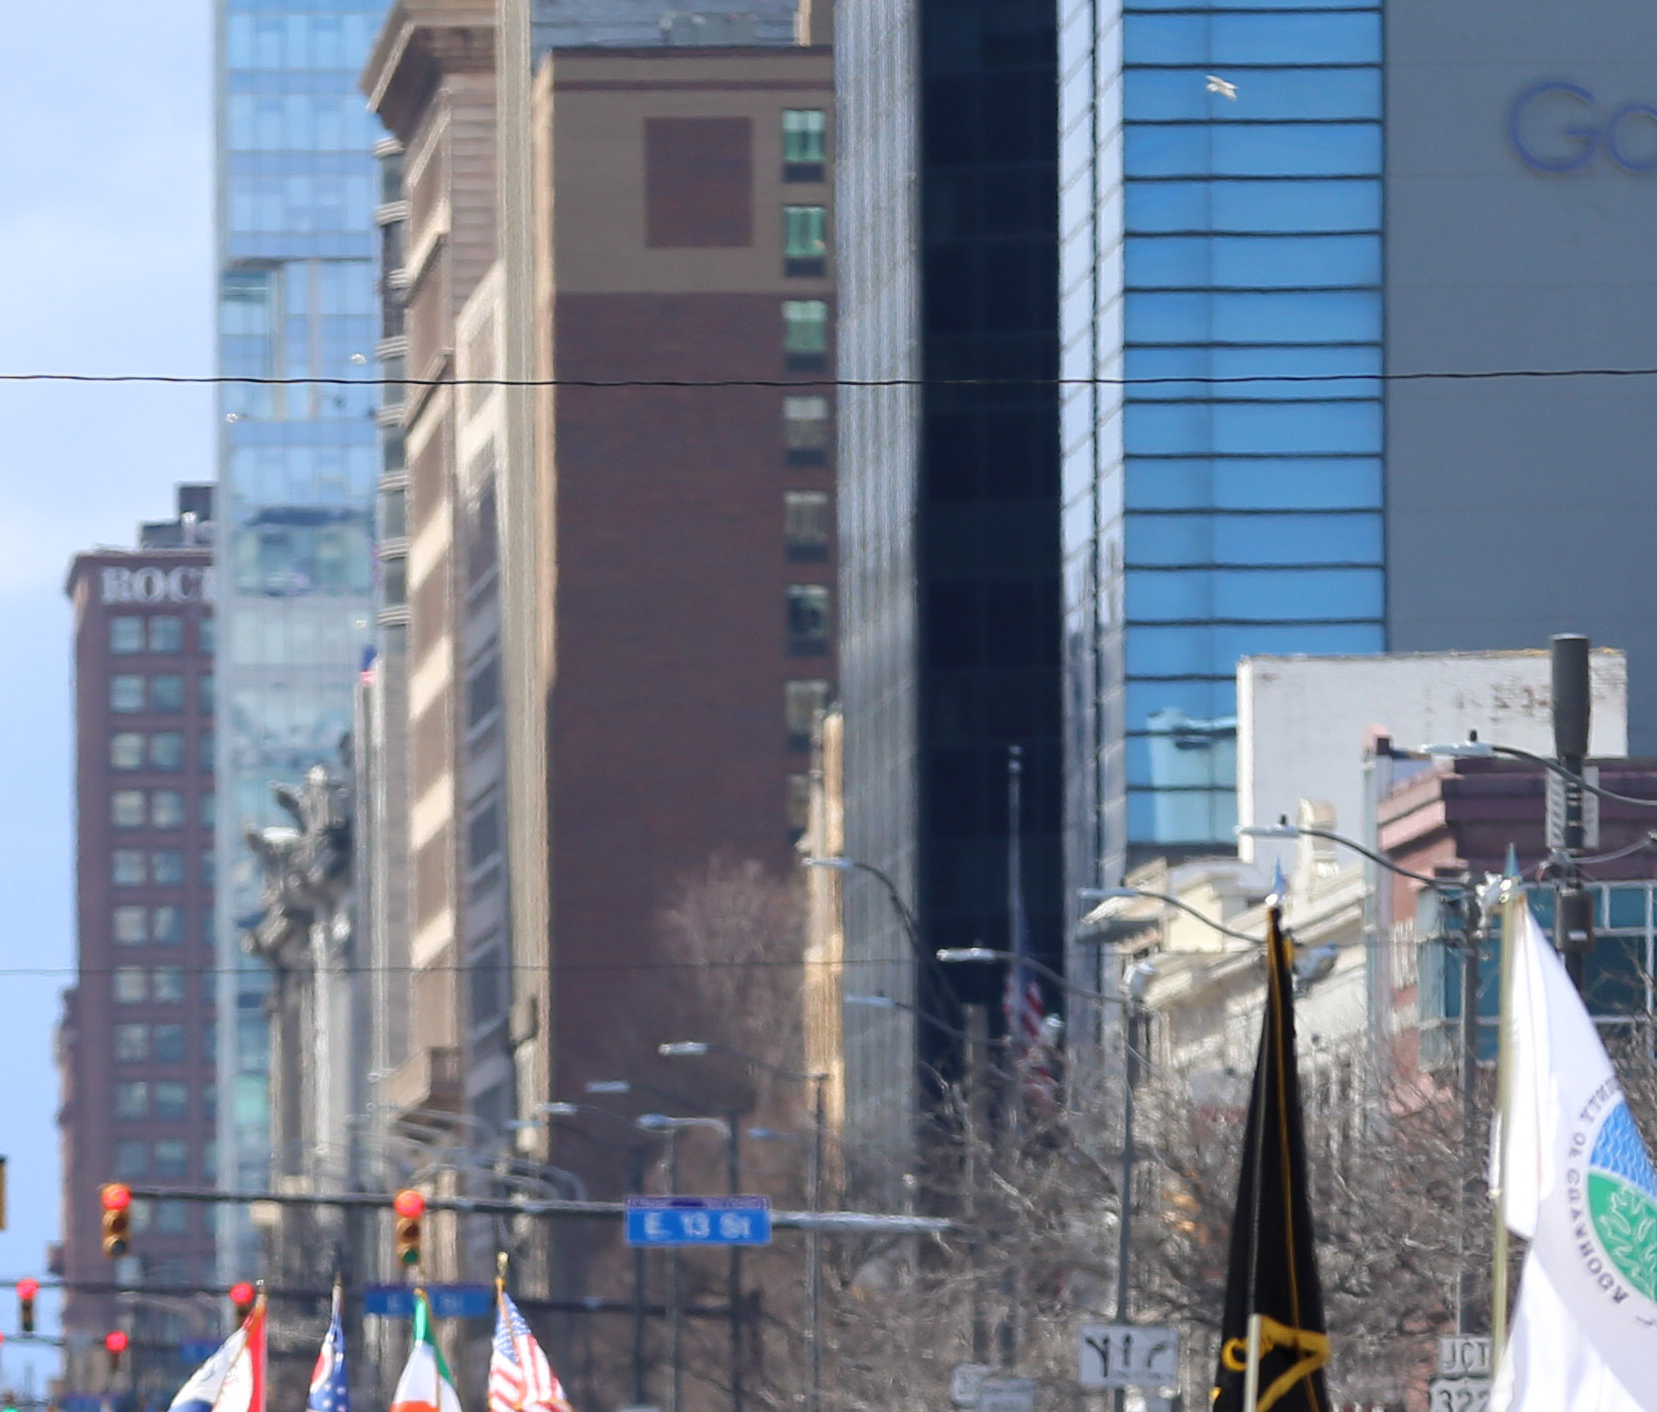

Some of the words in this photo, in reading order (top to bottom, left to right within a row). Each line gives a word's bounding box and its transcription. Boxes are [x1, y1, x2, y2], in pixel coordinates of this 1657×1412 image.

[680, 1211, 711, 1239] 13
[719, 1211, 752, 1239] St
[1442, 1341, 1491, 1369] JCT
